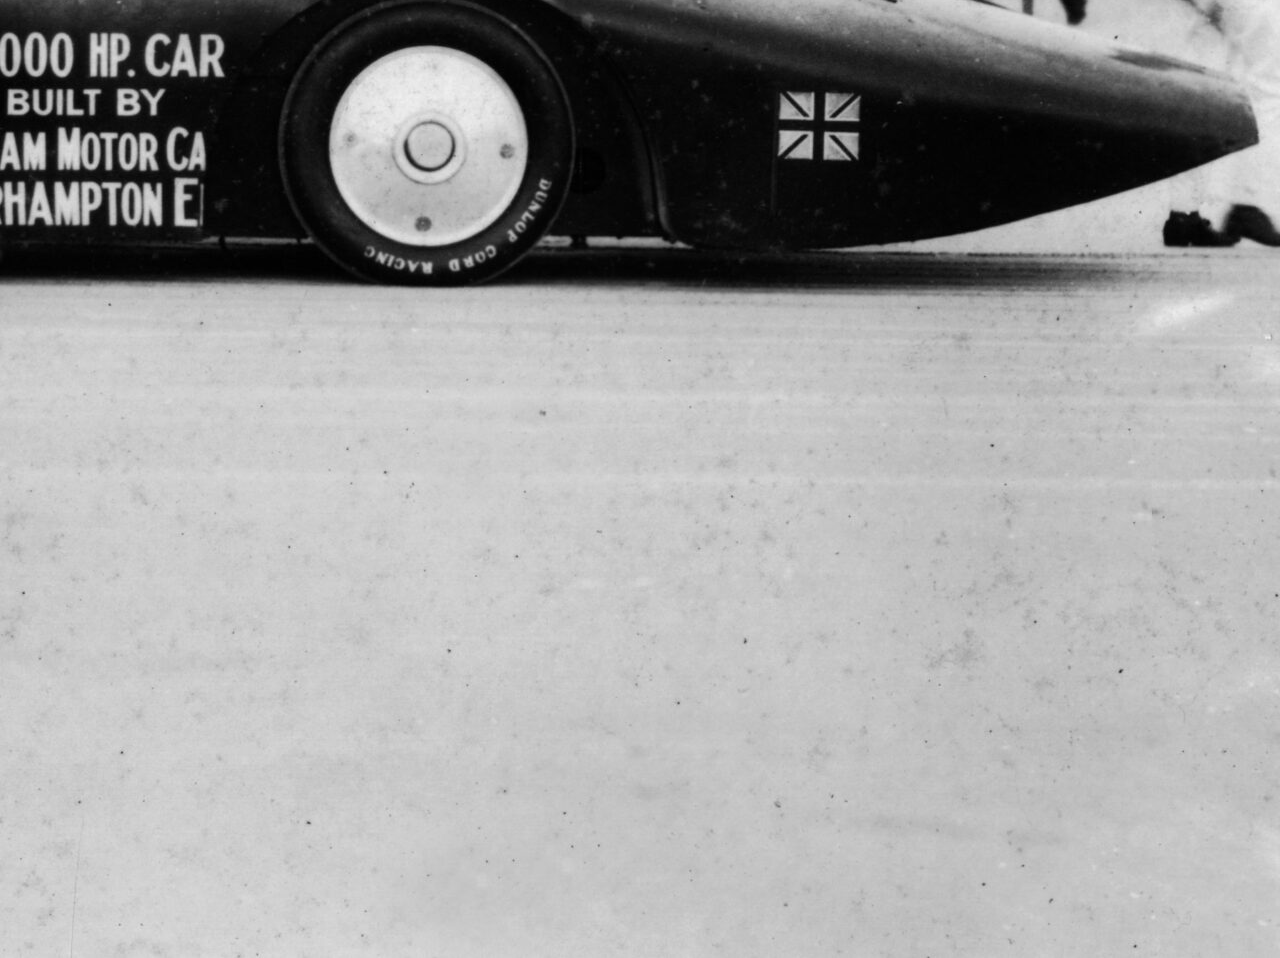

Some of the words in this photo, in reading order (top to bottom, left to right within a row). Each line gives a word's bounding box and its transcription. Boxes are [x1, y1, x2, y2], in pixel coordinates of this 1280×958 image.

[89, 31, 136, 78] HP.
[144, 32, 226, 78] CAR
[7, 88, 102, 116] BUILT
[116, 88, 166, 117] BY
[57, 126, 159, 172] MOTOR
[506, 178, 552, 243] DUNLOP
[448, 244, 497, 272] CORD
